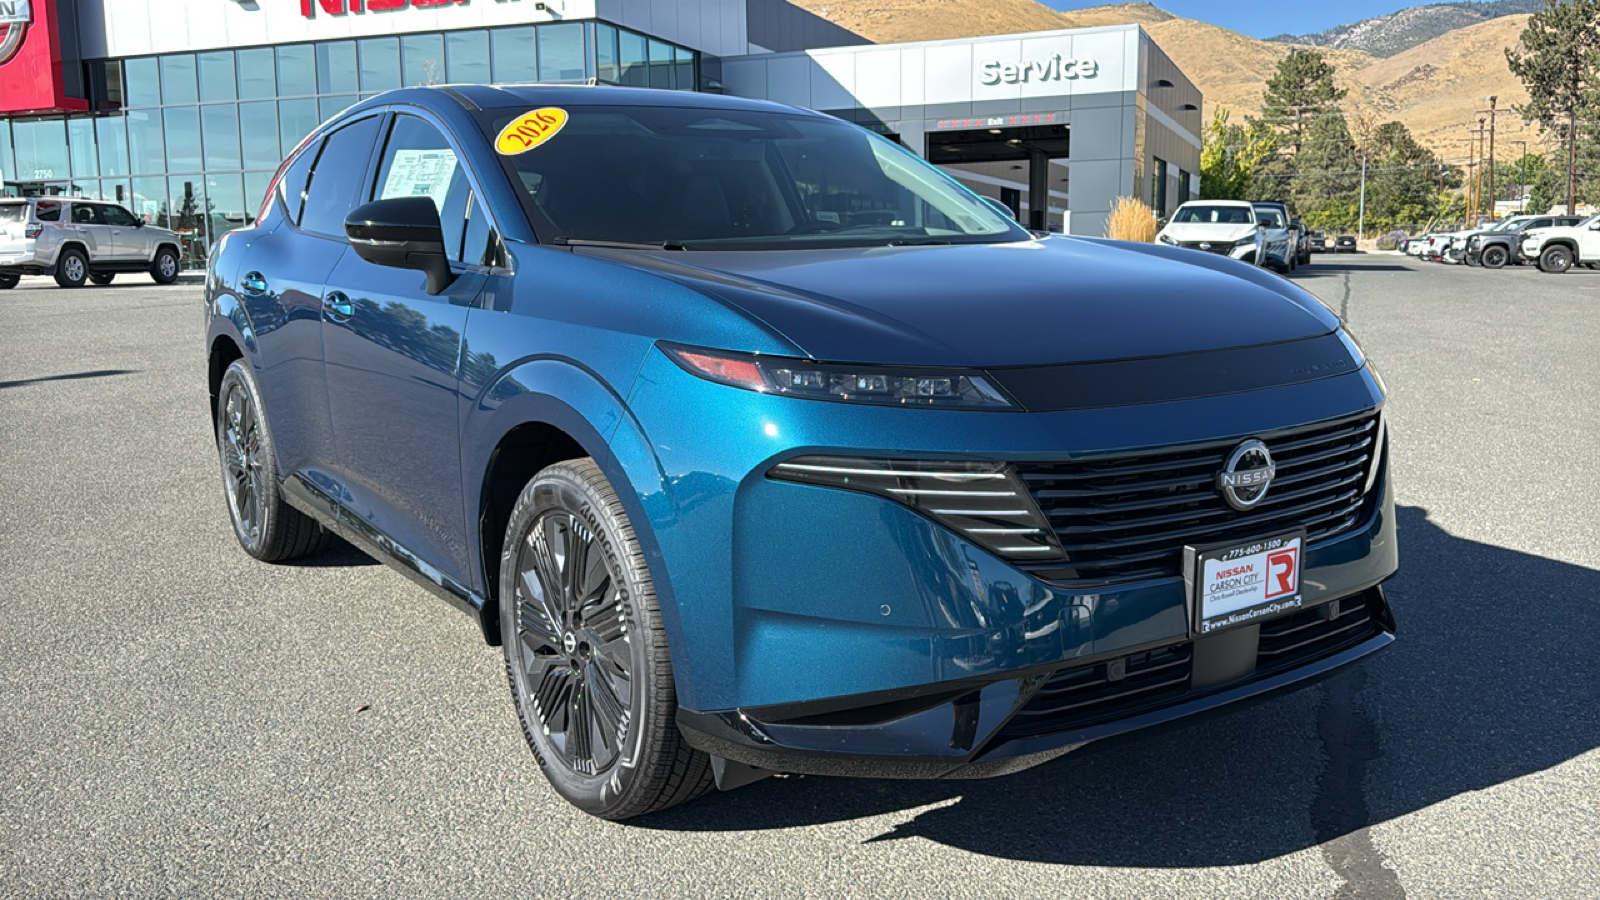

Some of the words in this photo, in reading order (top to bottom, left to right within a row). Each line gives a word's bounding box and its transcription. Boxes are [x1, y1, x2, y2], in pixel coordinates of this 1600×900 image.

[980, 53, 1099, 86] Service
[507, 112, 556, 147] 2026
[987, 117, 1004, 126] Exit
[34, 169, 53, 179] 2750
[1224, 469, 1275, 486] NISSAN
[1229, 539, 1282, 559] 775-600-1500
[1216, 563, 1254, 580] NISSAN
[1210, 577, 1241, 592] CARSON
[1243, 572, 1259, 584] CITY
[1211, 601, 1294, 629] www.NissanCarsonCity.com
